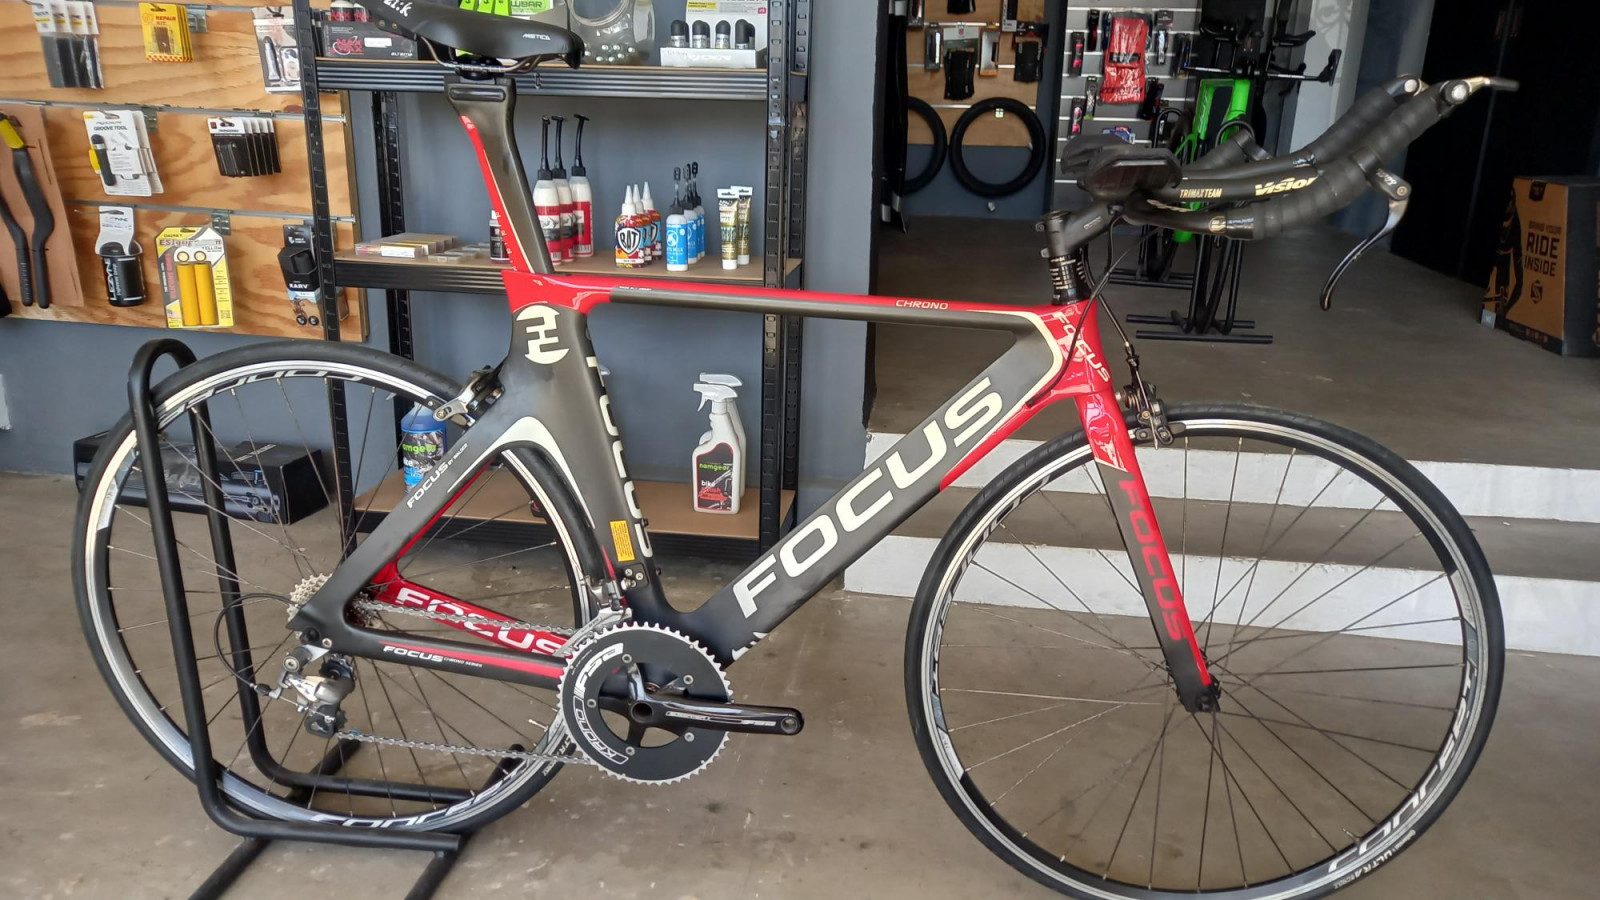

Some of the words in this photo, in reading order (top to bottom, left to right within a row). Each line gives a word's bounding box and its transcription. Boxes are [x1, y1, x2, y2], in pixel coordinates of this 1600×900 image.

[619, 231, 639, 253] BAT
[1526, 232, 1560, 259] RIDE
[1524, 255, 1556, 277] INSIDE
[896, 299, 949, 310] CHRONO
[1051, 311, 1111, 382] FOCUS
[699, 463, 730, 471] namgear
[407, 462, 449, 509] FOCUS
[732, 376, 1003, 619] FOCUS
[1118, 480, 1188, 641] FOCUS
[382, 645, 443, 662] FOCUS
[574, 643, 624, 694] FSA
[1354, 849, 1393, 878] ULTRA
